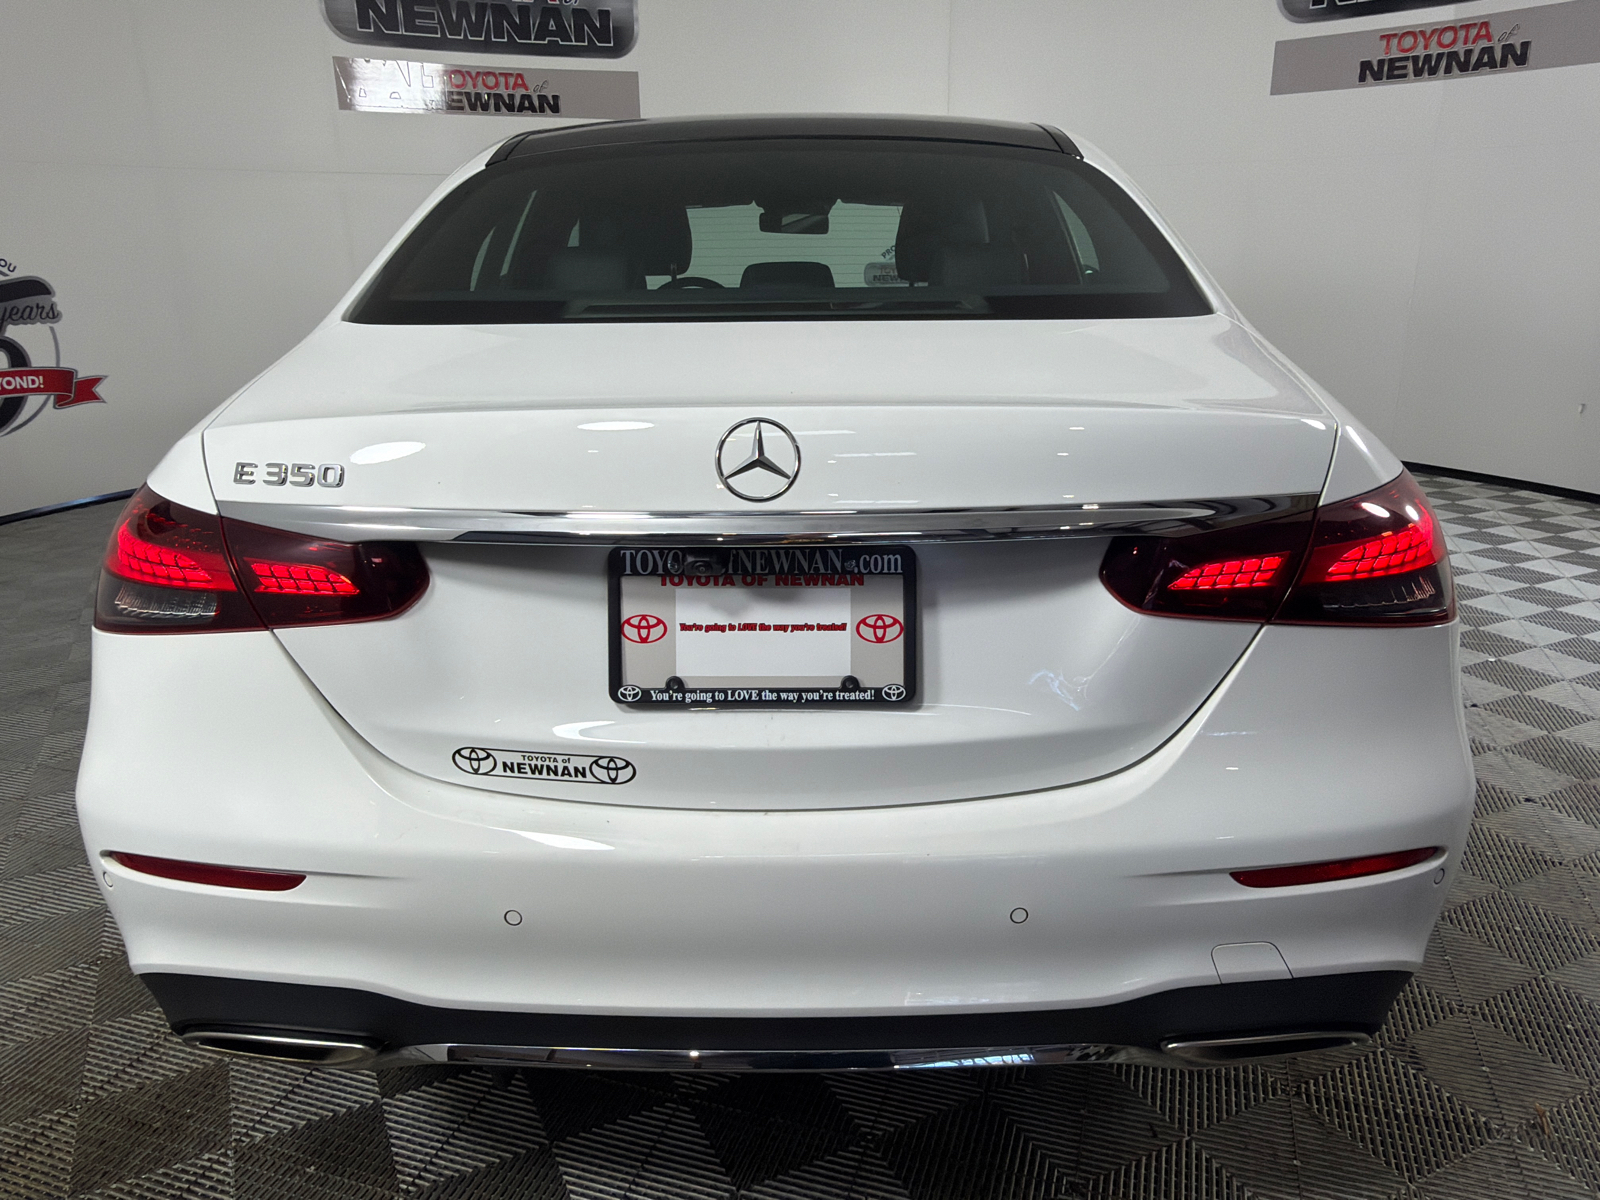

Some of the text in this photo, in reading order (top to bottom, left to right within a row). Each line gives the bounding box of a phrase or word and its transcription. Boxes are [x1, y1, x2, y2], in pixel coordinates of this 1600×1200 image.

[356, 0, 614, 46] NEWNAN
[1379, 21, 1520, 55] TOYOTA of
[1357, 40, 1532, 84] NEWNAN
[448, 69, 550, 93] OYOTA of
[446, 91, 560, 114] EWNAN
[0, 258, 17, 273] OU
[233, 462, 346, 489] E 350
[660, 574, 865, 587] TOYOTA OF NEWNAN
[685, 690, 713, 703] going
[714, 691, 725, 700] to
[727, 690, 759, 700] LOVE
[761, 690, 778, 700] the
[780, 692, 799, 703] way
[835, 690, 875, 701] treated!
[502, 761, 587, 779] NEWNAN
[521, 754, 559, 764] TOYOTA
